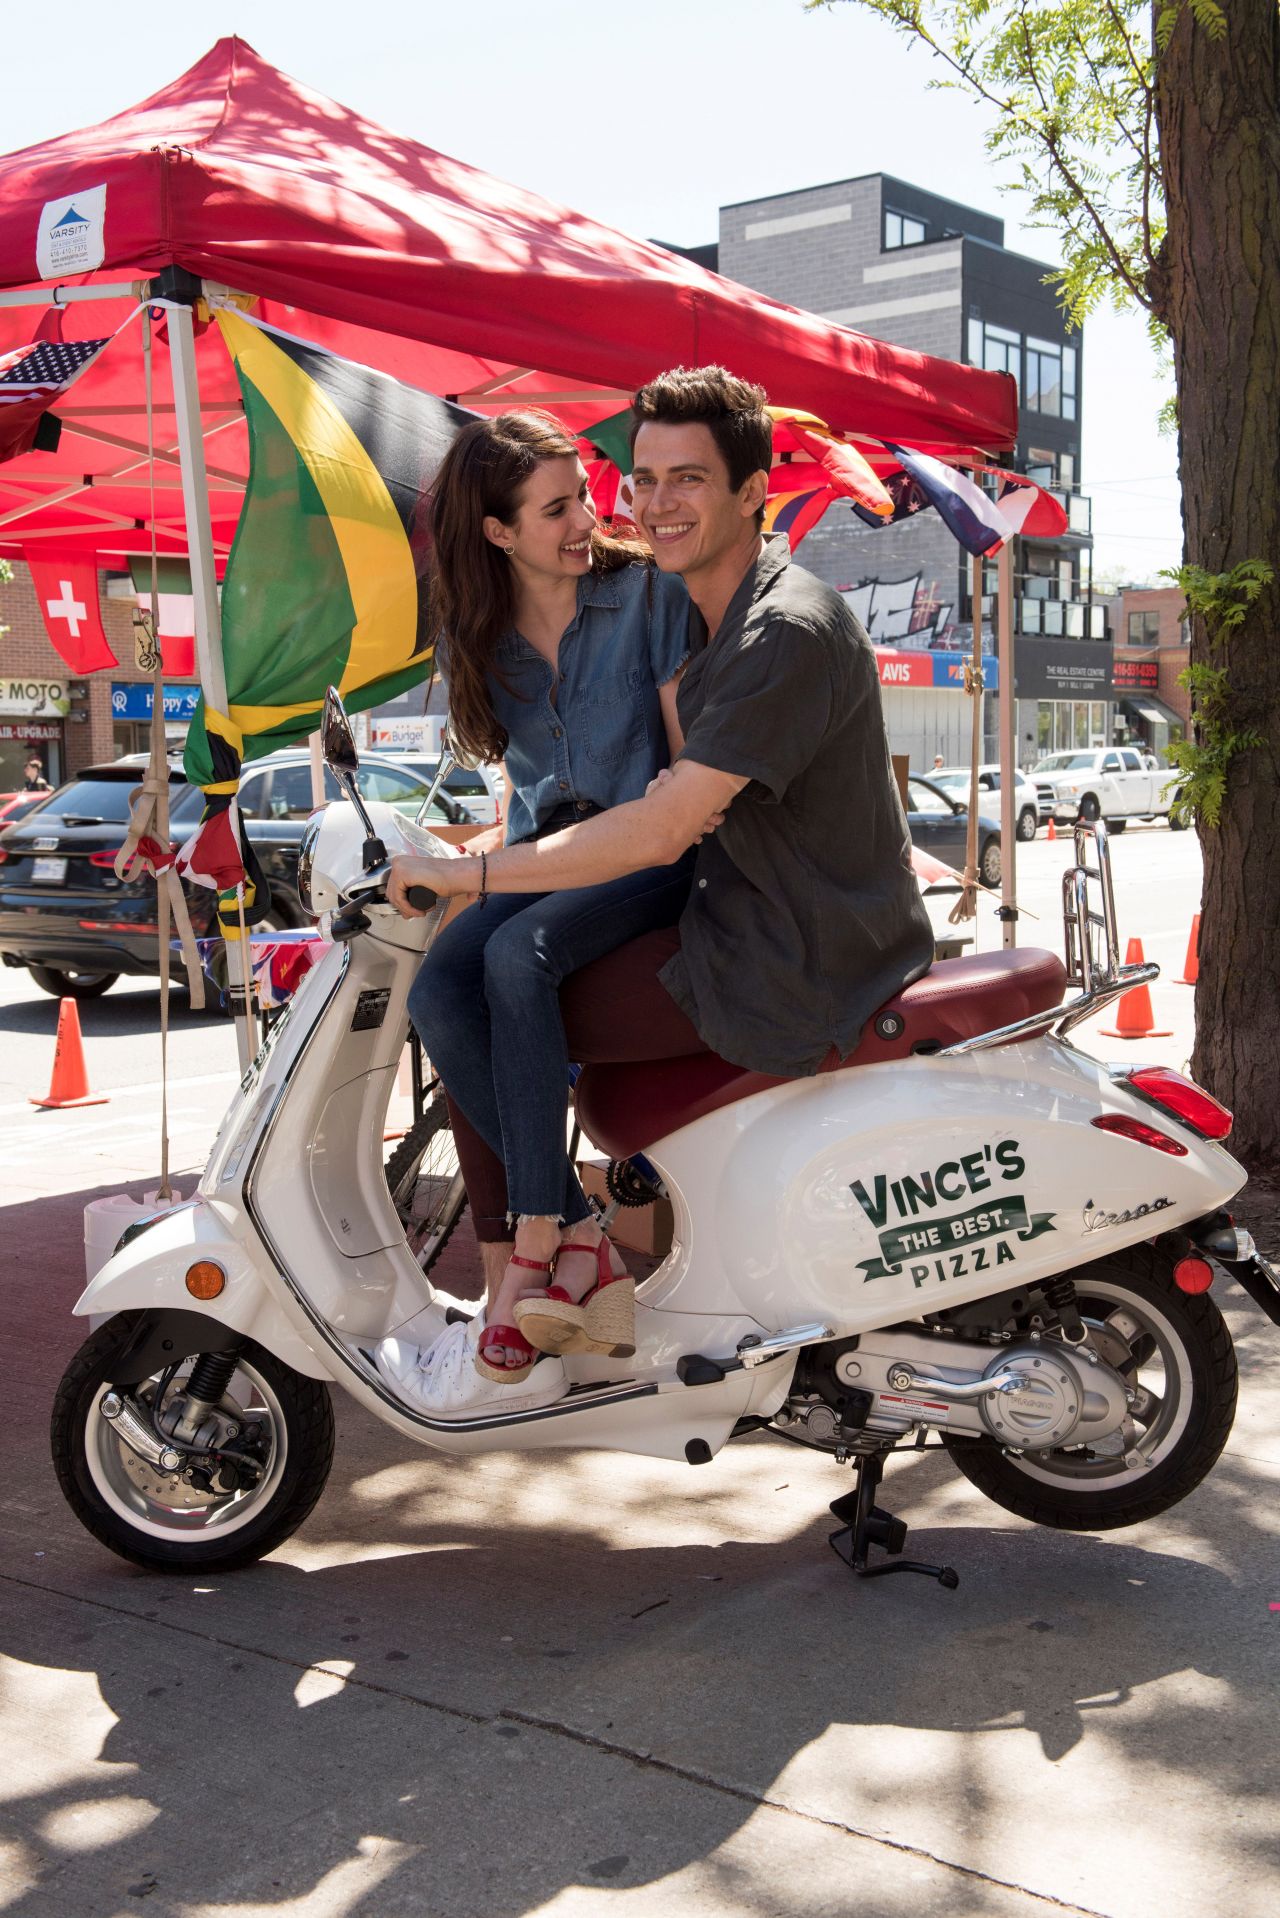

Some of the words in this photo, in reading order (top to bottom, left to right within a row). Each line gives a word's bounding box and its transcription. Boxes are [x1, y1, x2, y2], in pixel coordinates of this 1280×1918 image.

[49, 224, 91, 240] VARSITY
[882, 663, 911, 682] AVIS
[1046, 665, 1057, 675] THE
[1057, 666, 1069, 676] REAL
[1069, 667, 1087, 677] ESTATE
[1087, 668, 1105, 678] CENTRE
[9, 683, 62, 700] MOTO
[146, 694, 183, 712] Hppy
[392, 731, 424, 744] Budget
[849, 1139, 1025, 1228] VINCE'S
[1081, 1198, 1177, 1236] Vespa
[898, 1227, 942, 1254] THE
[950, 1209, 1010, 1240] BEST.
[910, 1240, 1016, 1288] PIZZA
